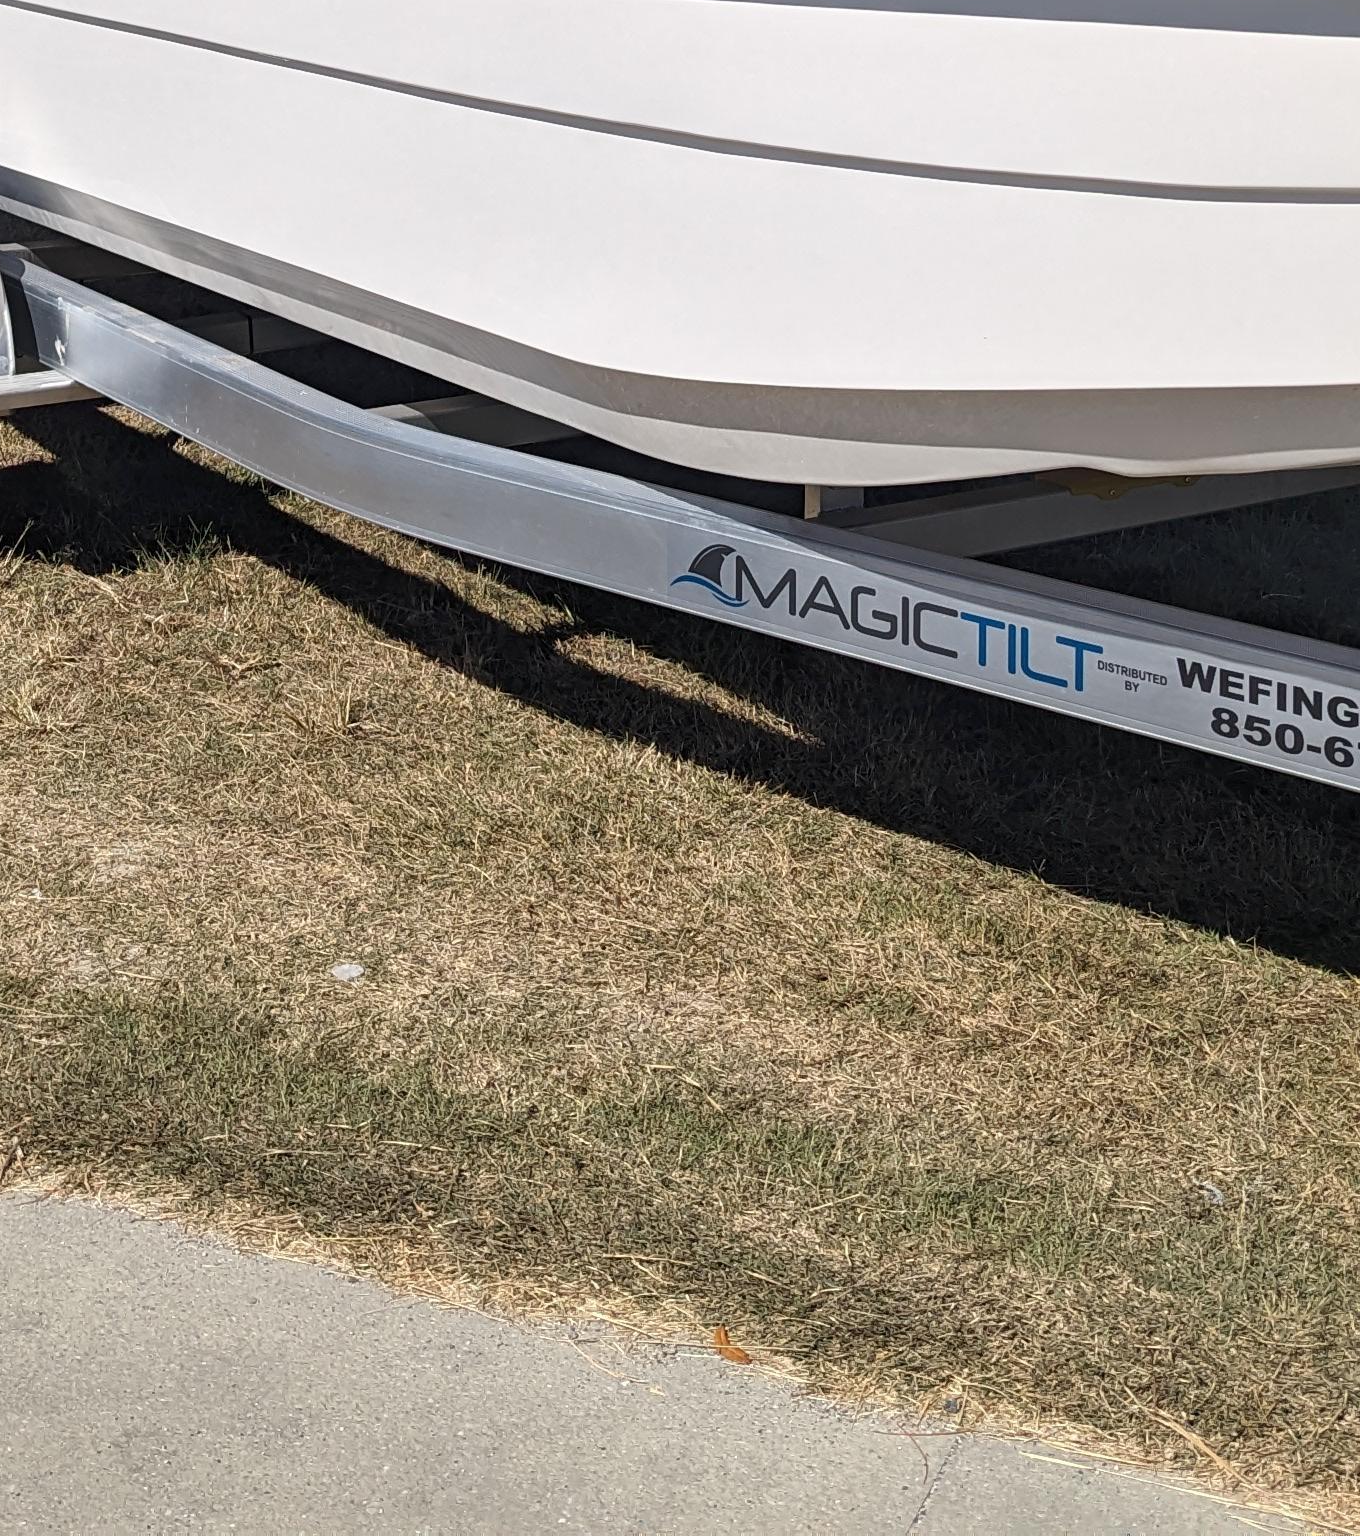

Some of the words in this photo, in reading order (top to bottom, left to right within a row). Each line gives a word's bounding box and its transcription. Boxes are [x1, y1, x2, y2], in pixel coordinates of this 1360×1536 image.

[735, 554, 1104, 693] MAGICTILT
[1097, 659, 1168, 687] DISTRIBUTED
[1124, 679, 1140, 694] BY
